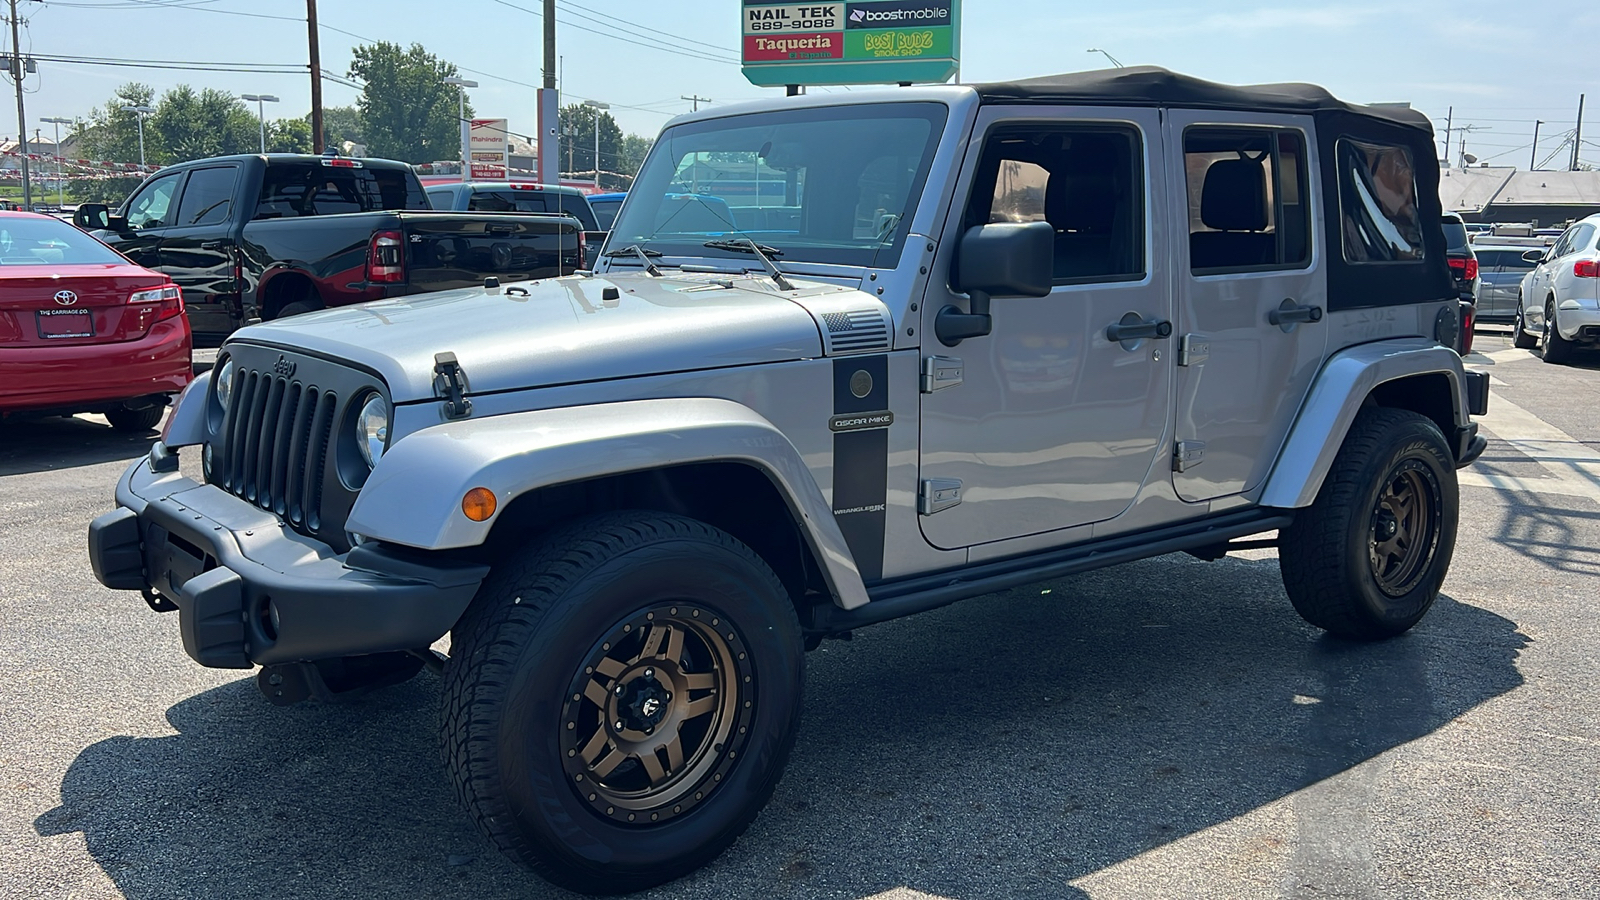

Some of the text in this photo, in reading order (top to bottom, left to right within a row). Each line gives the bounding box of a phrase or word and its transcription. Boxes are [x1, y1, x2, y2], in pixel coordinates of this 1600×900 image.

[749, 6, 836, 20] NAIL TEK
[751, 19, 835, 31] 689-9088
[897, 30, 933, 49] BUDZ
[874, 48, 923, 57] SMOKE SHOP
[273, 354, 297, 380] Jeep
[835, 415, 890, 427] OSCAR MIKE
